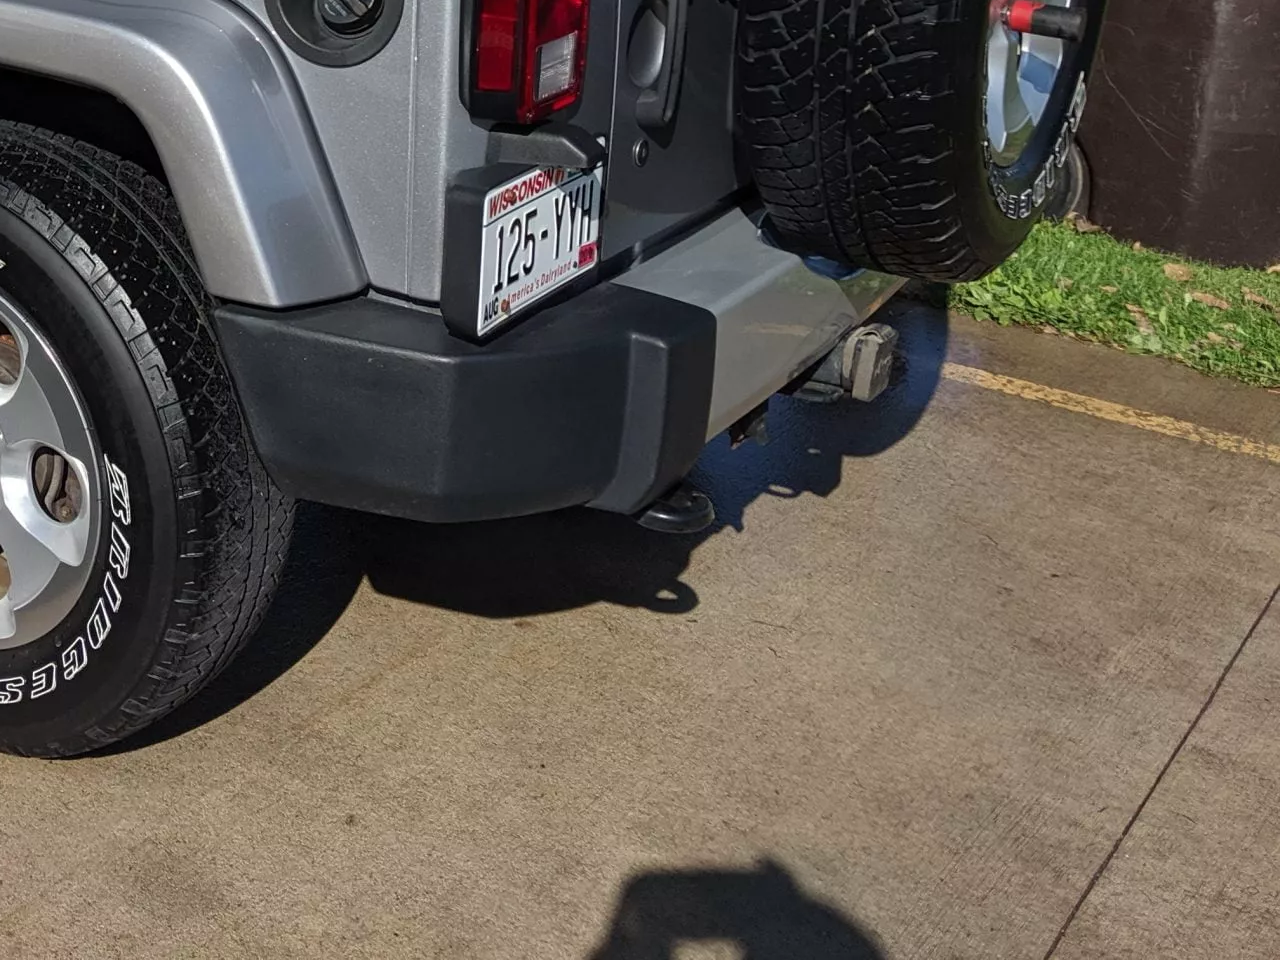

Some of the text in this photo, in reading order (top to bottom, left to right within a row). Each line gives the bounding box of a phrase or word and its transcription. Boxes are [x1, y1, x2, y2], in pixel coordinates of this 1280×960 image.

[489, 167, 555, 218] WISCONSIN
[493, 180, 594, 294] 125-YYH
[541, 259, 573, 287] Dairyland
[483, 296, 500, 324] AUG
